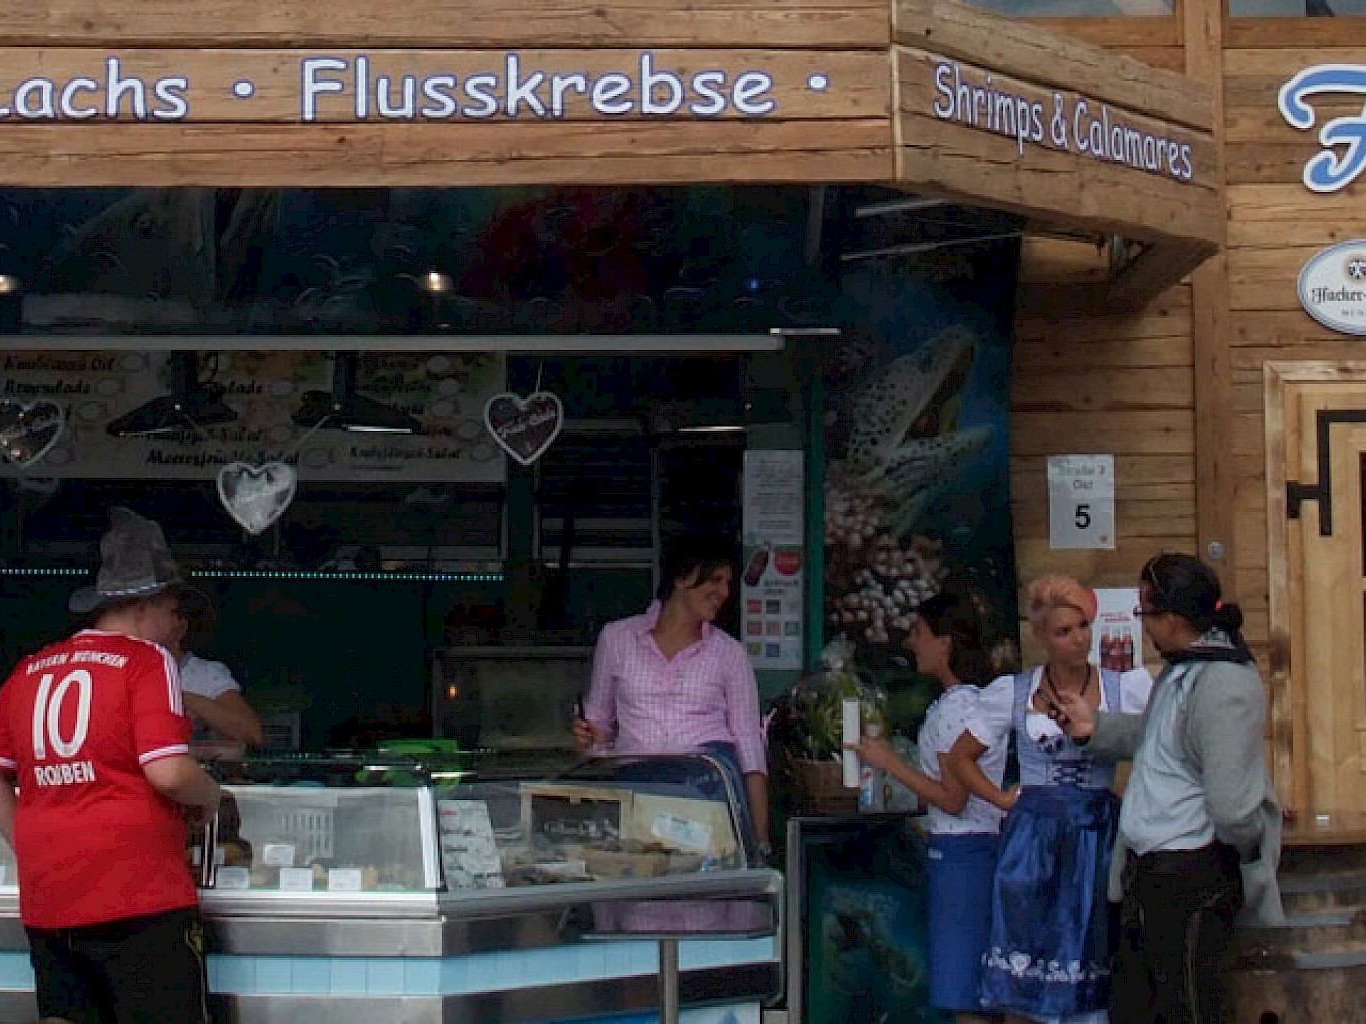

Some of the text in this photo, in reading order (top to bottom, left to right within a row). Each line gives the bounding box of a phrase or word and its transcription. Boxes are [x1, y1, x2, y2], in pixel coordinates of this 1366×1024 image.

[300, 53, 777, 122] Flusskrebse
[934, 60, 1193, 180] Shrimps & Calamares
[1075, 503, 1091, 530] 5
[32, 668, 93, 760] 10
